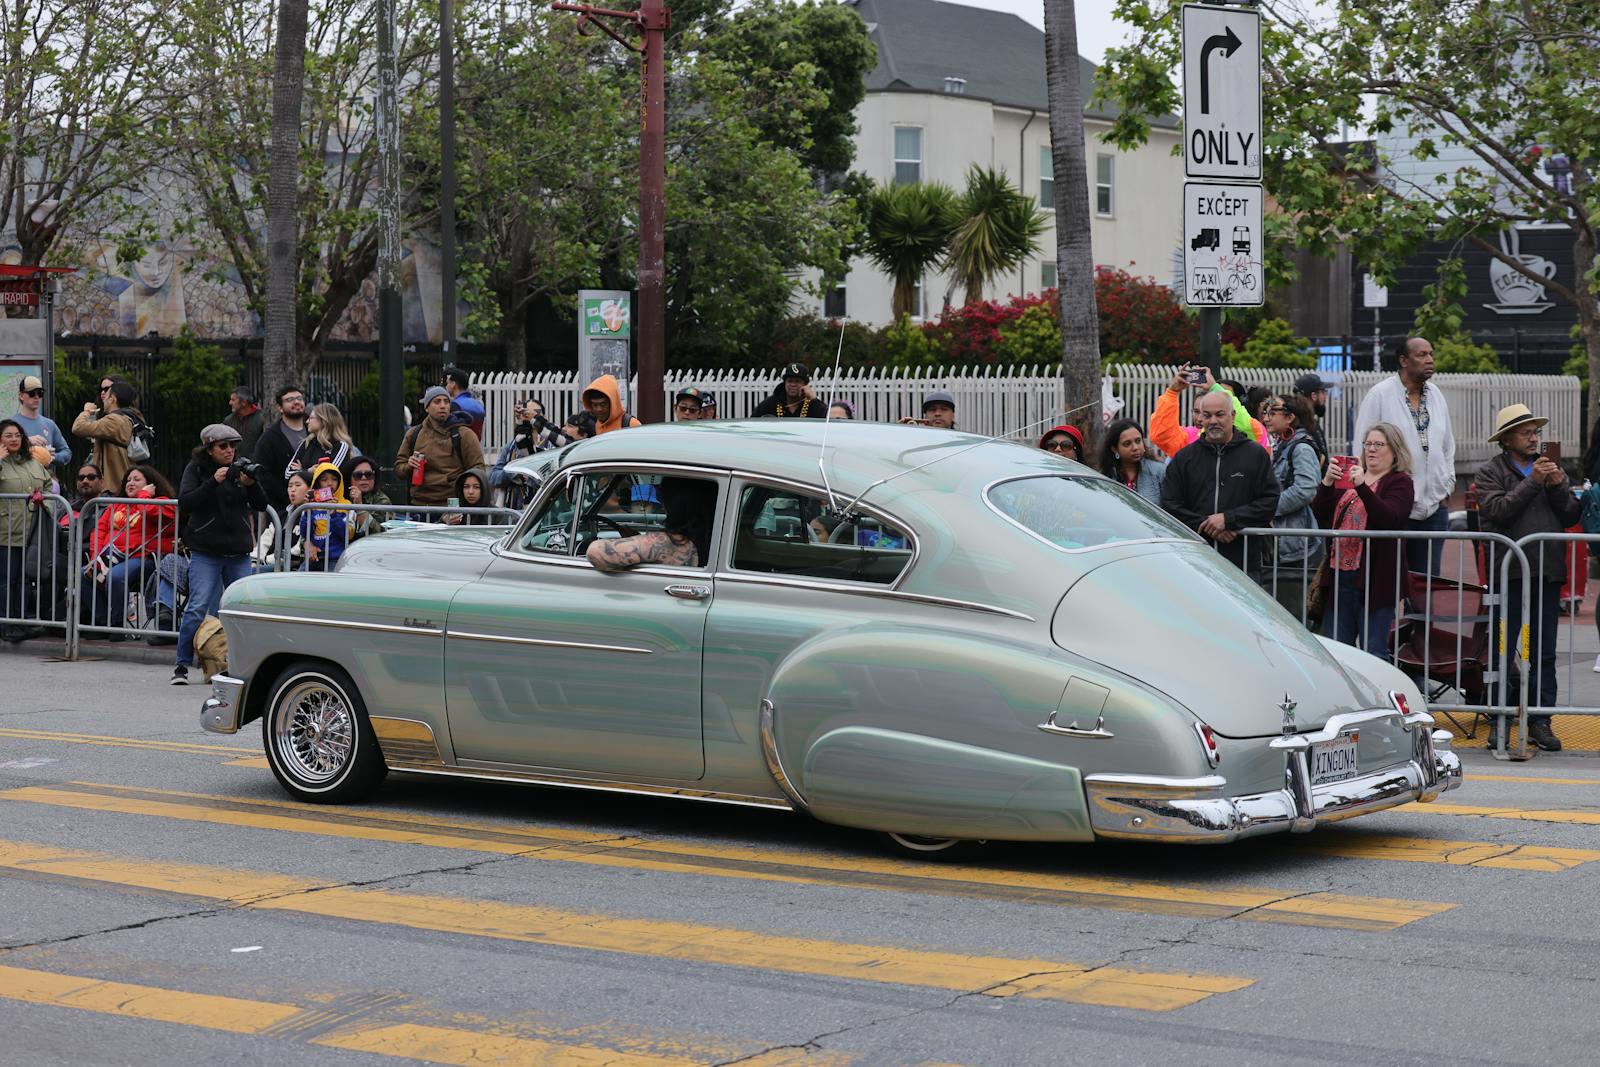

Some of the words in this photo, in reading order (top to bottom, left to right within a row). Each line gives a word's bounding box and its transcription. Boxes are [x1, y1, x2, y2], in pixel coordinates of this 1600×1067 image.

[1191, 128, 1254, 167] ONLY
[1198, 197, 1249, 217] EXCEPT
[1195, 273, 1217, 286] TAXI
[1495, 270, 1539, 291] COFF
[4, 292, 29, 305] RAPID
[1315, 747, 1355, 775] XINGONA
